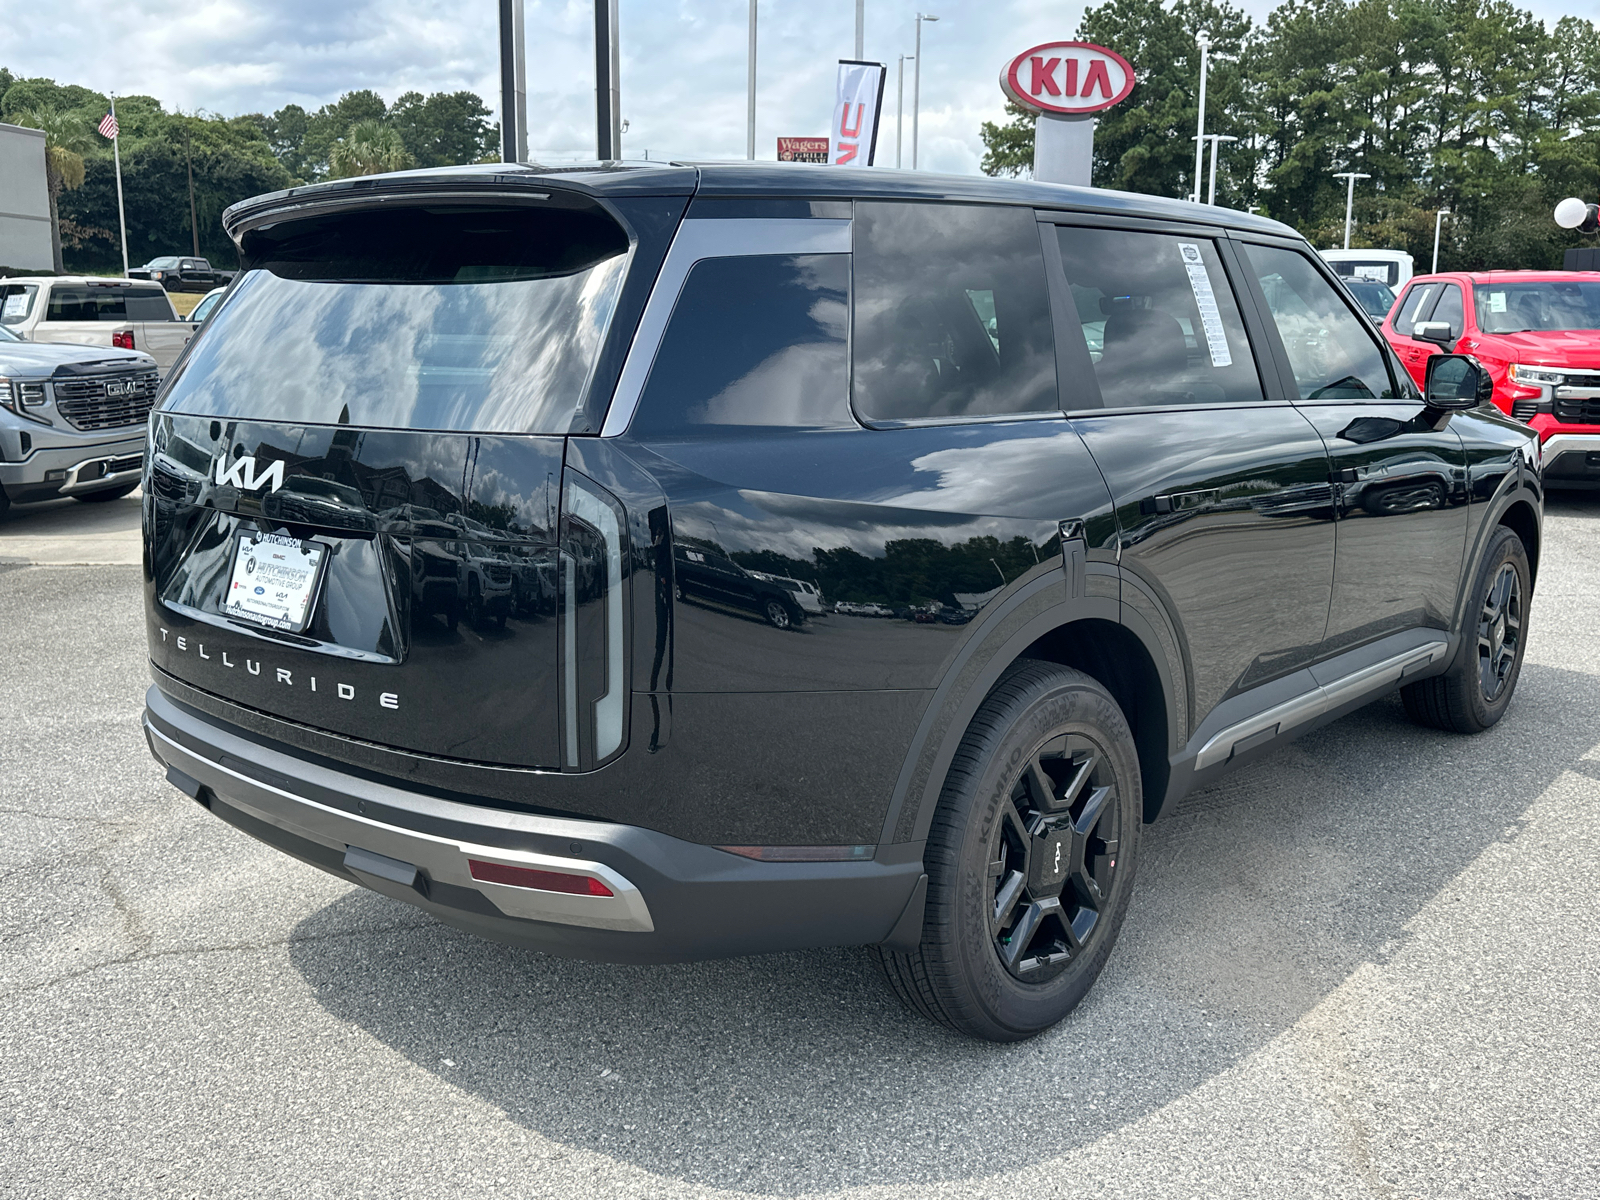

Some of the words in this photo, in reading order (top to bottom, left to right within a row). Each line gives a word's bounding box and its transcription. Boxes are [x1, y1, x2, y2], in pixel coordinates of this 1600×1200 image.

[1030, 56, 1113, 98] KIA
[780, 138, 827, 152] Wagers
[107, 381, 145, 396] GMC
[215, 453, 285, 494] KIA
[263, 533, 302, 548] HUTCHINSON
[255, 574, 285, 588] AUTOMOTIVE
[285, 581, 303, 591] GROUP
[256, 561, 309, 583] HUTCHINSON
[159, 627, 399, 710] TELLURIDE
[979, 747, 1021, 844] KUMHO
